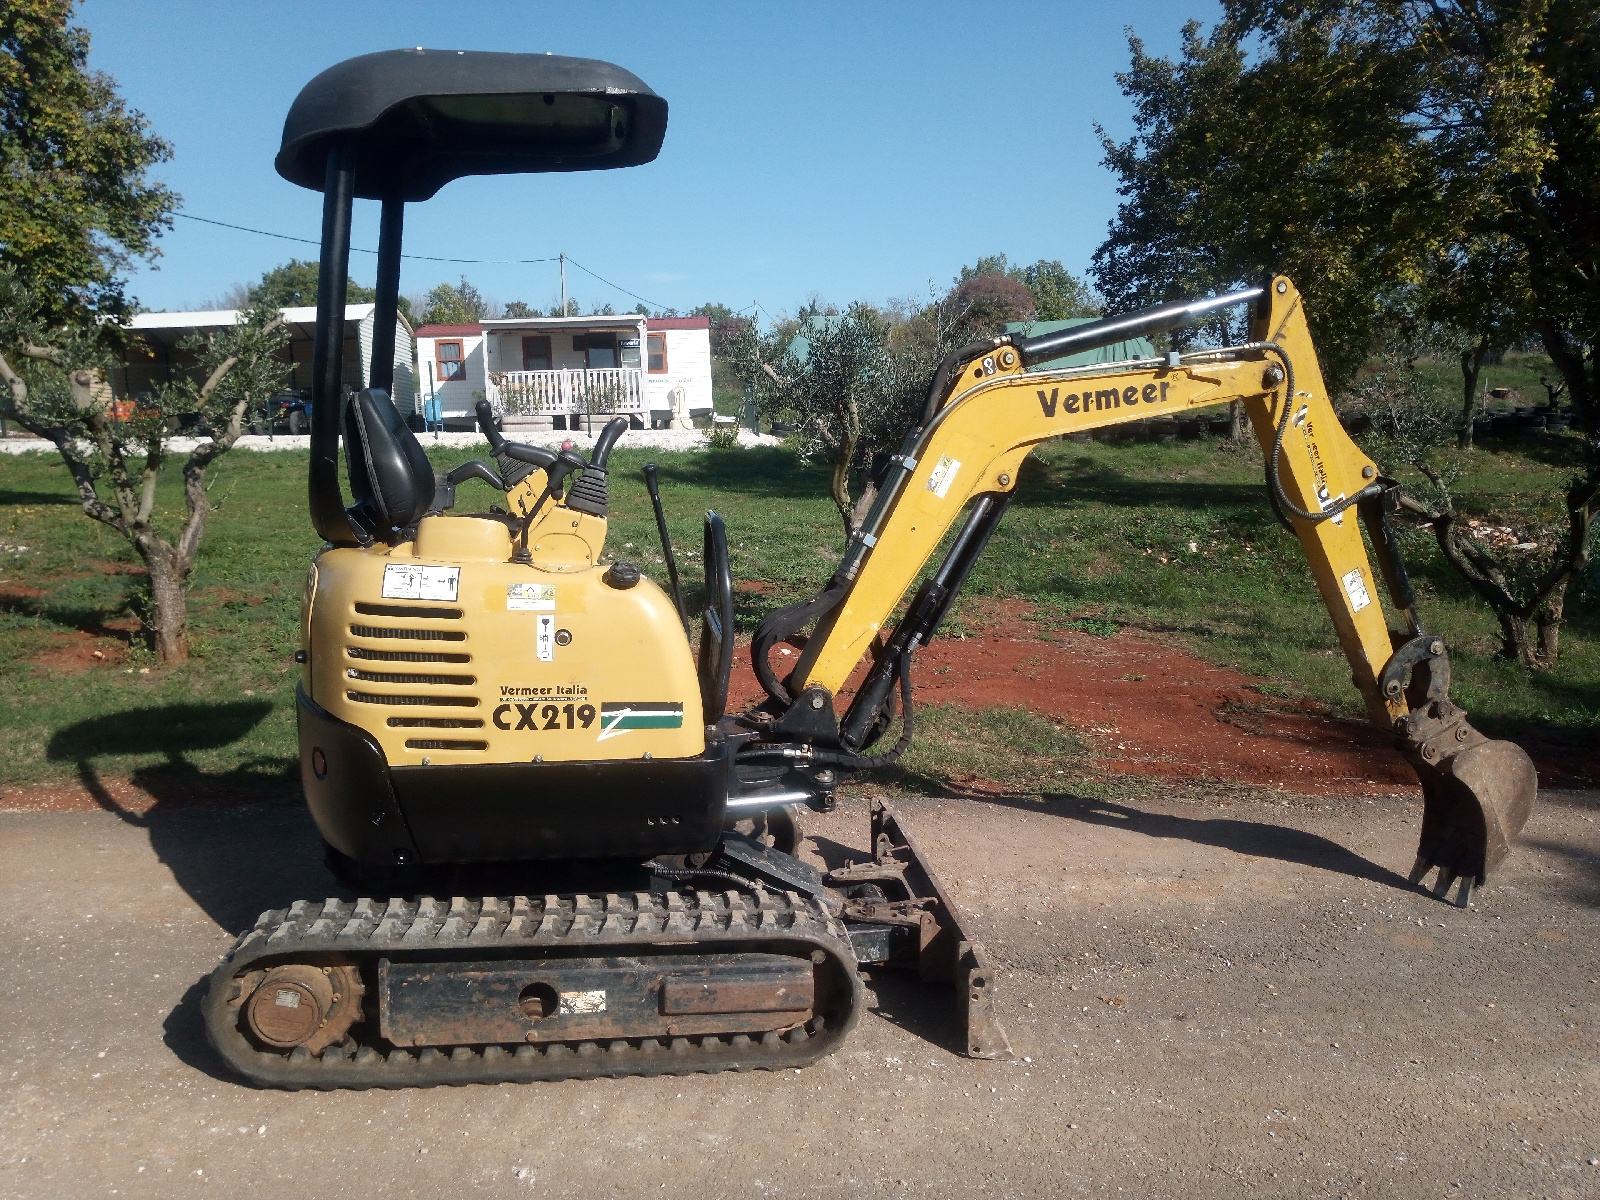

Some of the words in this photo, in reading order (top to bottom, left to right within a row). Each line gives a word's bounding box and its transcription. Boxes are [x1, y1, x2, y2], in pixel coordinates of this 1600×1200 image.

[1037, 381, 1170, 418] Vermeer
[1306, 421, 1320, 460] Vereer
[500, 685, 552, 696] Vermeer
[556, 685, 588, 695] Italia
[492, 703, 596, 731] CX219
